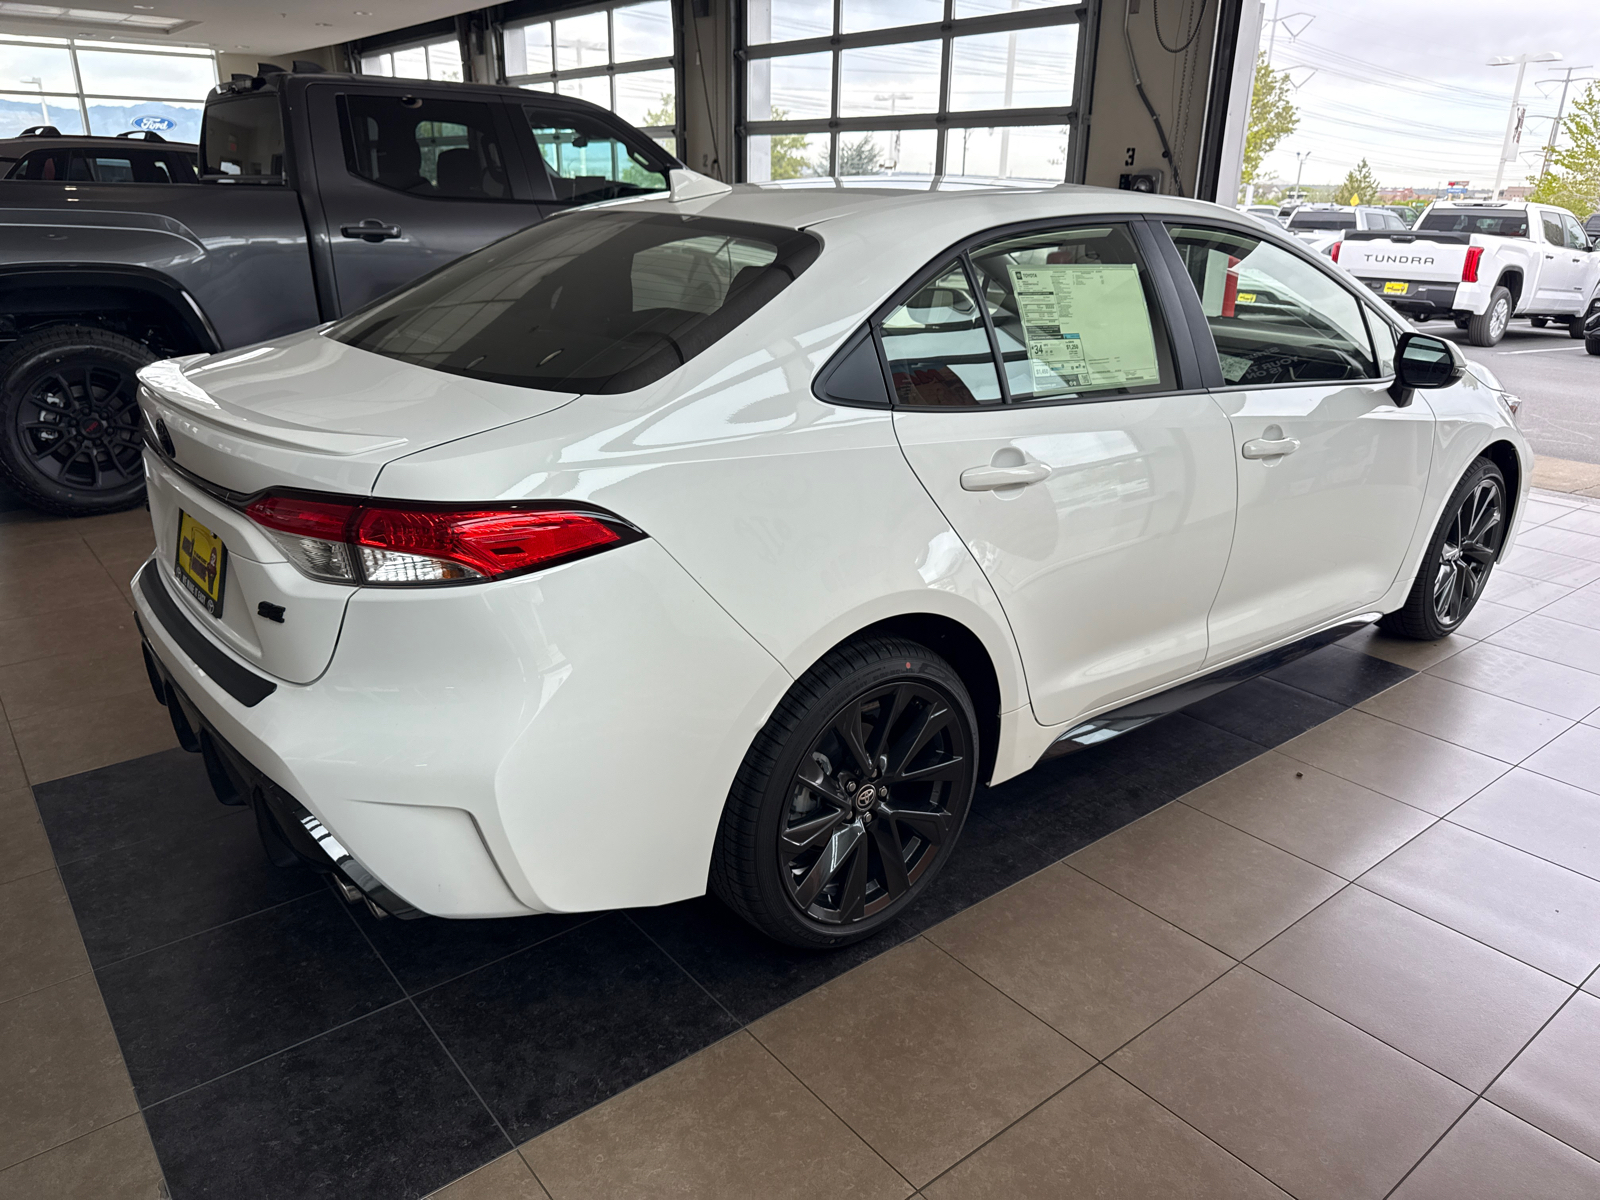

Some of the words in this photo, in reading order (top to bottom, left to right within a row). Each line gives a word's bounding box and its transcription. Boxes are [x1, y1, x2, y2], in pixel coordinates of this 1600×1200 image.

[140, 117, 169, 130] Ford
[702, 153, 709, 167] 2
[1124, 147, 1136, 166] 3
[1364, 253, 1435, 265] TUNDRA
[1034, 344, 1043, 354] 34
